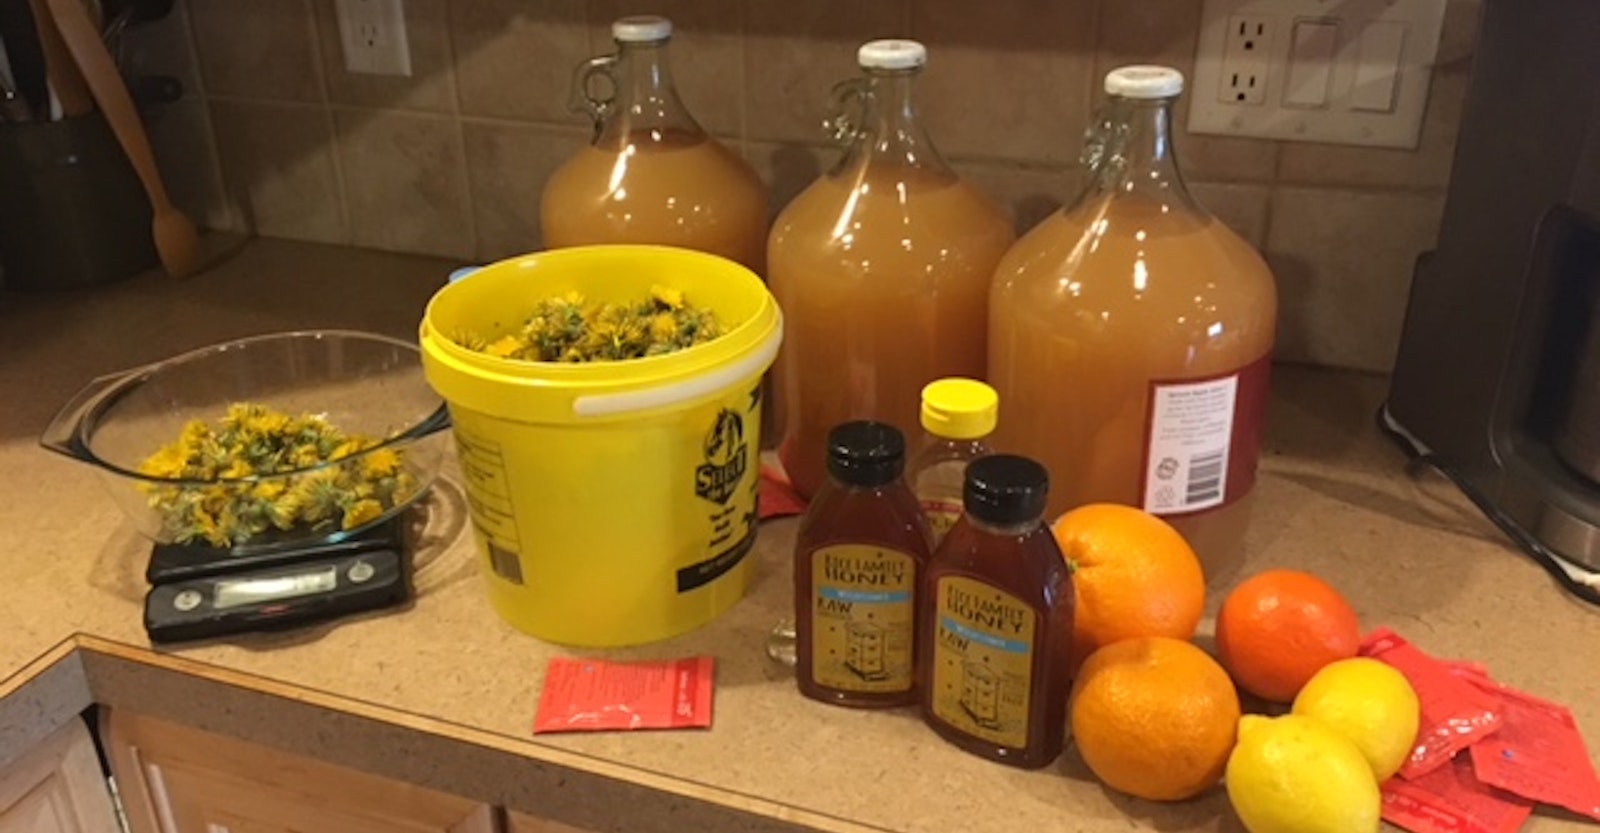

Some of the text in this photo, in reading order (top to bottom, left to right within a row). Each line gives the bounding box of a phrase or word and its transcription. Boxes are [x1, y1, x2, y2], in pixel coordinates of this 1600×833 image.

[824, 566, 904, 585] HONEY
[816, 597, 854, 614] RAW
[946, 597, 1023, 634] HONEY
